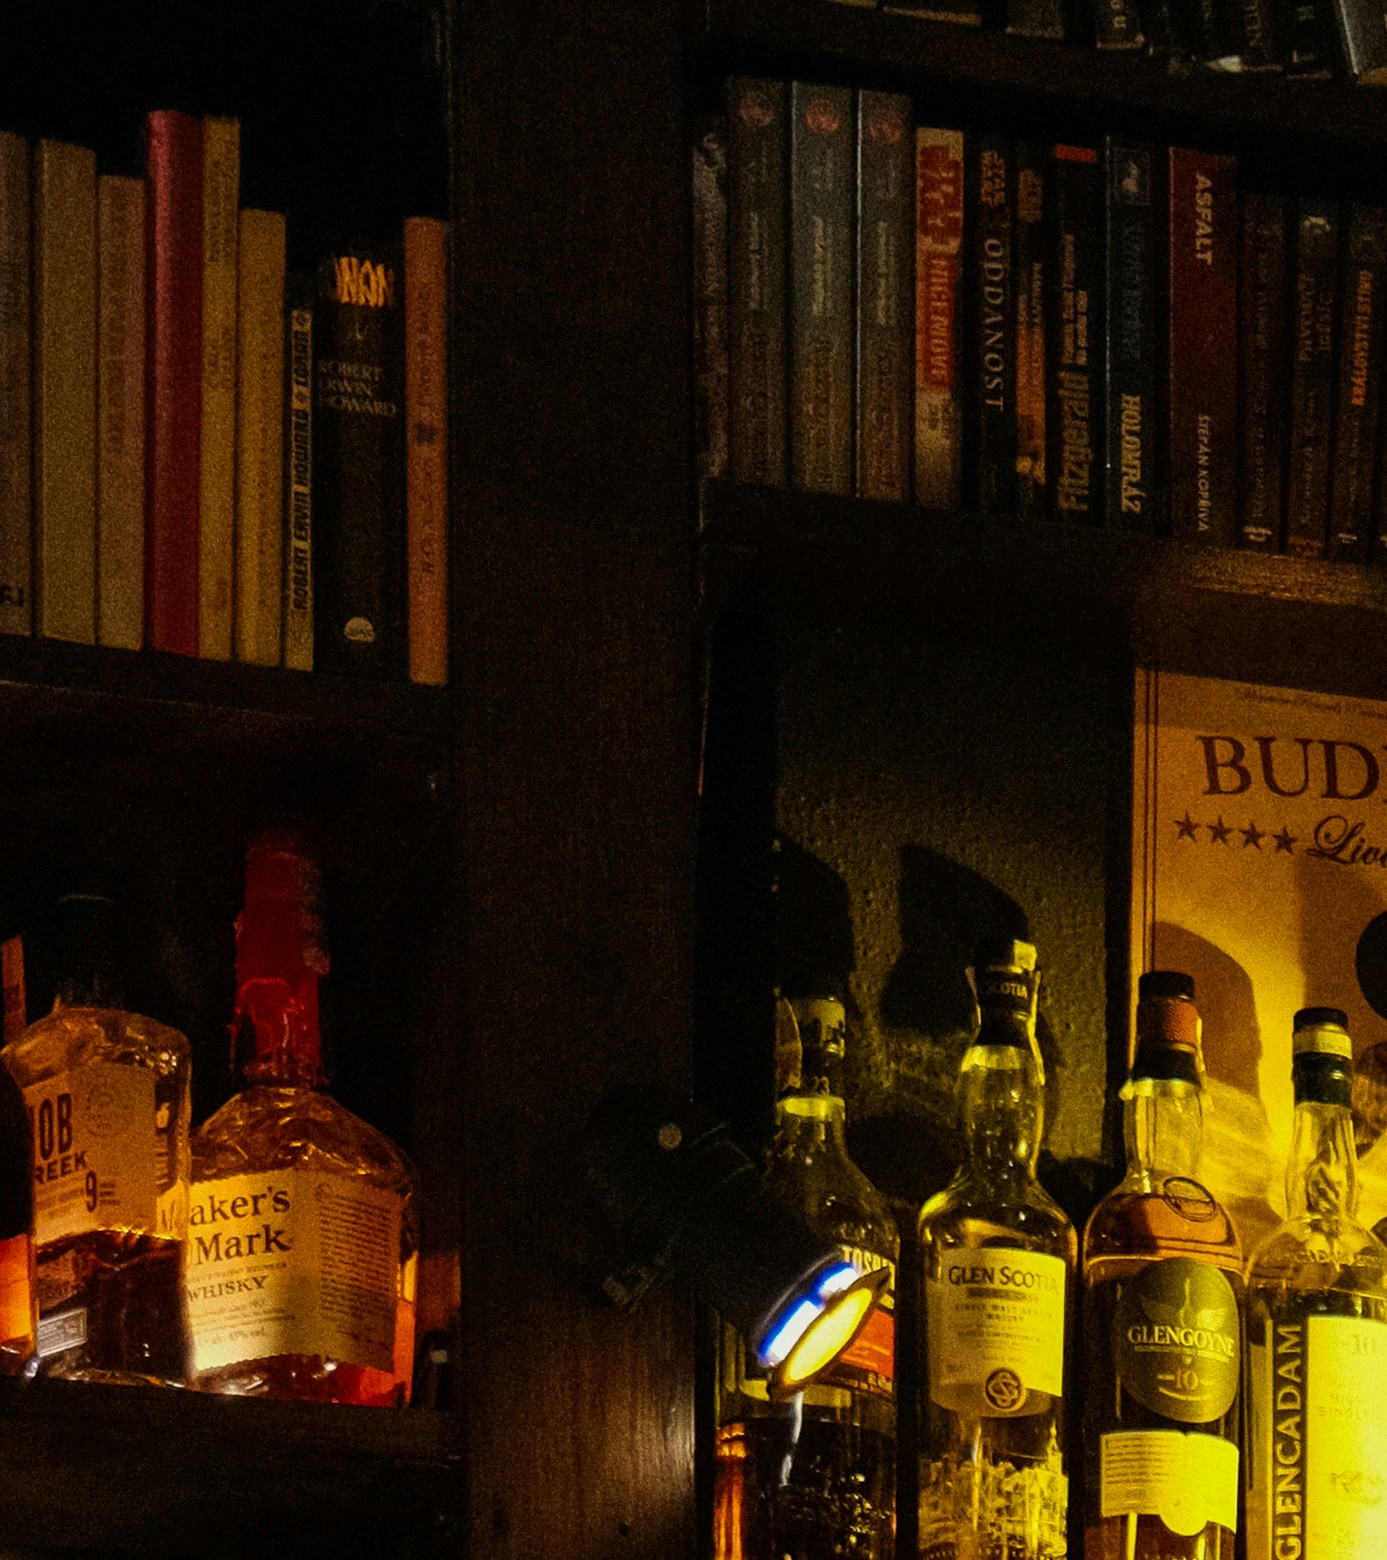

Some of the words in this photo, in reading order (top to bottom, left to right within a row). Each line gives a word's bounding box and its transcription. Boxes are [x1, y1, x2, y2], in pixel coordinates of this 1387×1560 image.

[1195, 172, 1213, 265] ASFALT
[982, 237, 1006, 411] ODDANOST
[1057, 371, 1093, 512] Fitzgerald
[38, 1092, 73, 1162] OB
[34, 1150, 88, 1185] REEK
[189, 1186, 292, 1227] aker's
[194, 1224, 294, 1267] Mark
[949, 1265, 995, 1285] GLEN
[1126, 1325, 1236, 1354] GLENGOYNE
